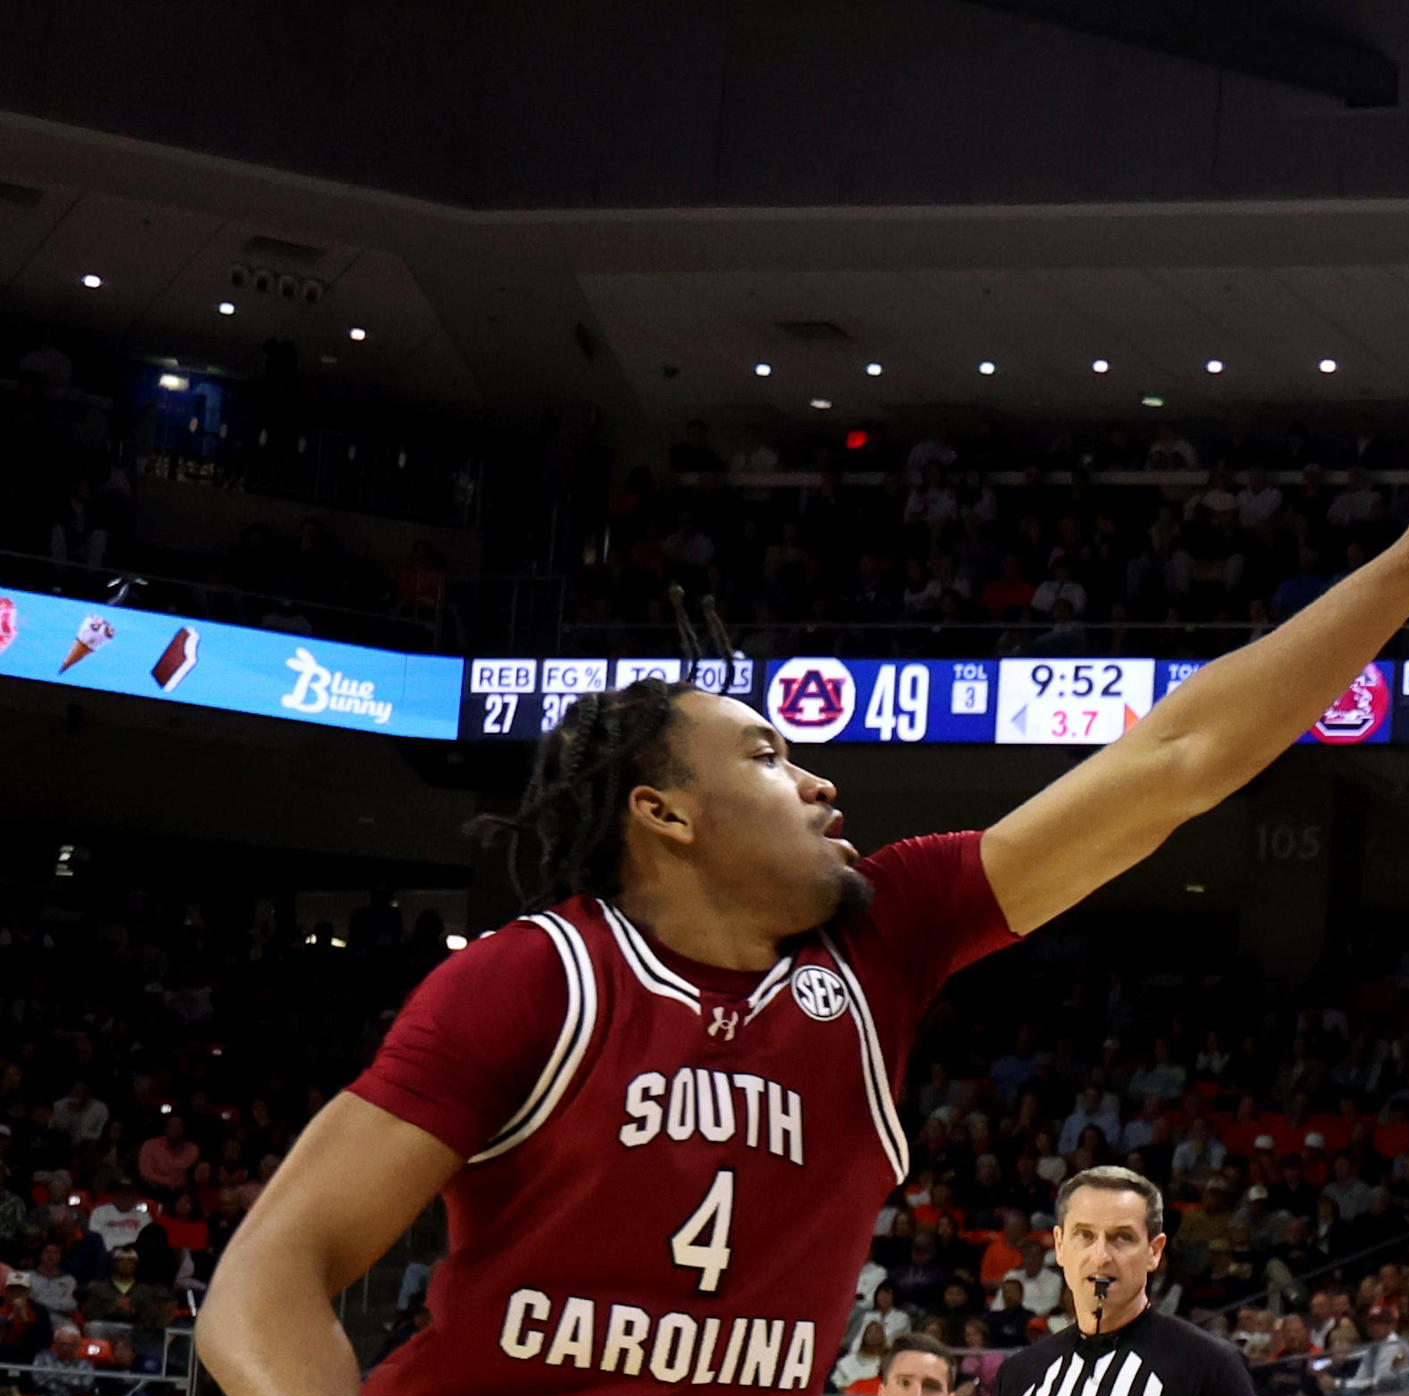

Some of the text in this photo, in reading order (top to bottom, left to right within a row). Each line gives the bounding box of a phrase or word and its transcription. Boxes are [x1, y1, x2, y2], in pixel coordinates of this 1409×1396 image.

[479, 667, 530, 687] REB
[547, 667, 578, 687] FG
[953, 664, 988, 679] TOL
[1031, 664, 1123, 697] 9:52
[483, 693, 519, 733] 27
[864, 664, 930, 741] 49
[965, 686, 976, 708] 3
[1051, 710, 1099, 737] 3.7
[1257, 824, 1321, 863] 105
[796, 969, 845, 1017] SEC
[619, 1066, 805, 1166] SOUTH
[670, 1170, 735, 1292] 4
[500, 1288, 816, 1390] CAROLINA
